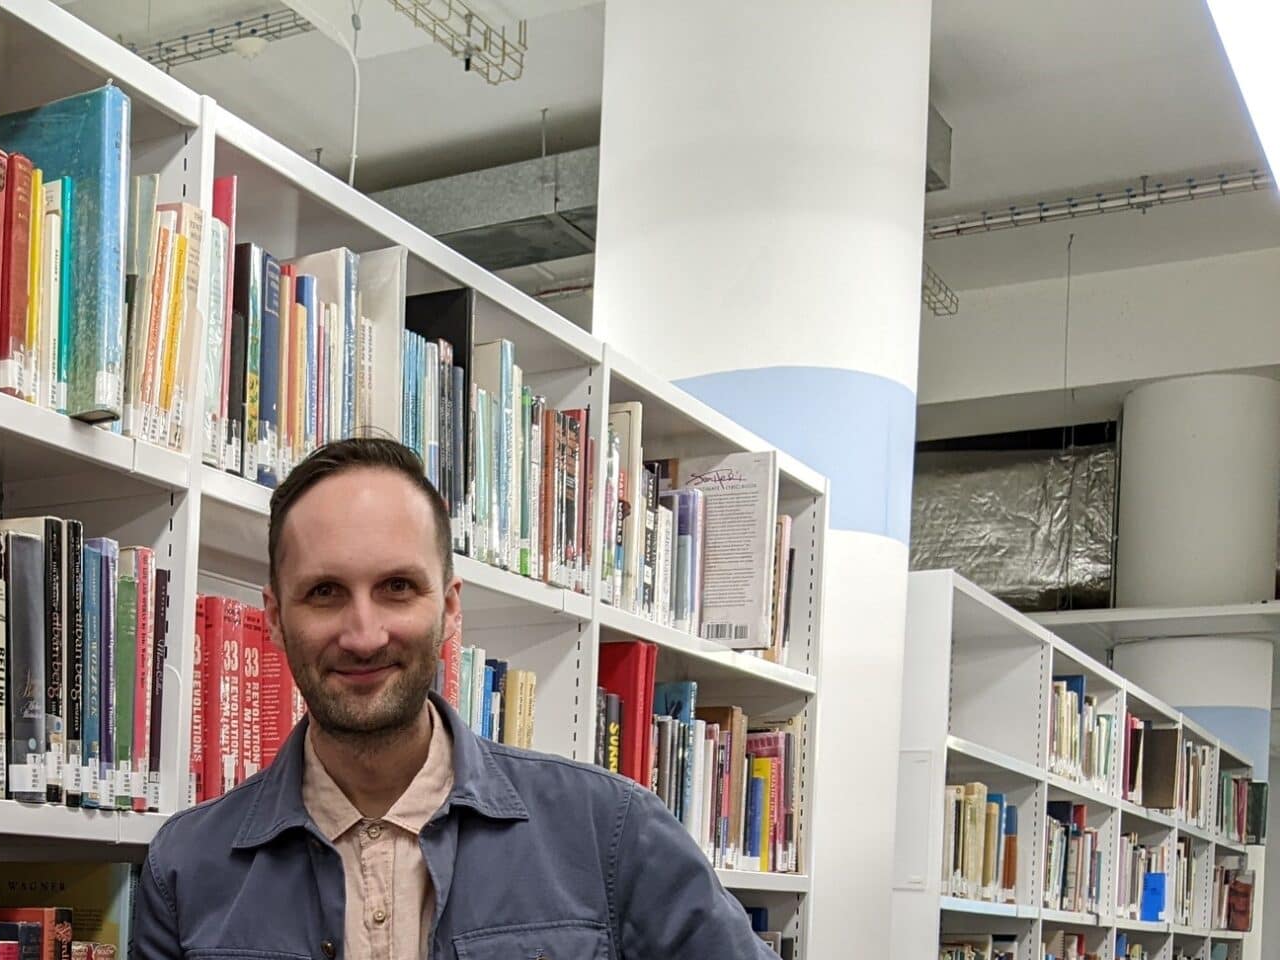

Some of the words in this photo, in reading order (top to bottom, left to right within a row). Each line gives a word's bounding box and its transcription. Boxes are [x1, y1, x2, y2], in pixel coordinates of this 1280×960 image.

[223, 640, 239, 671] 33
[243, 647, 260, 678] 33
[47, 662, 63, 698] berg
